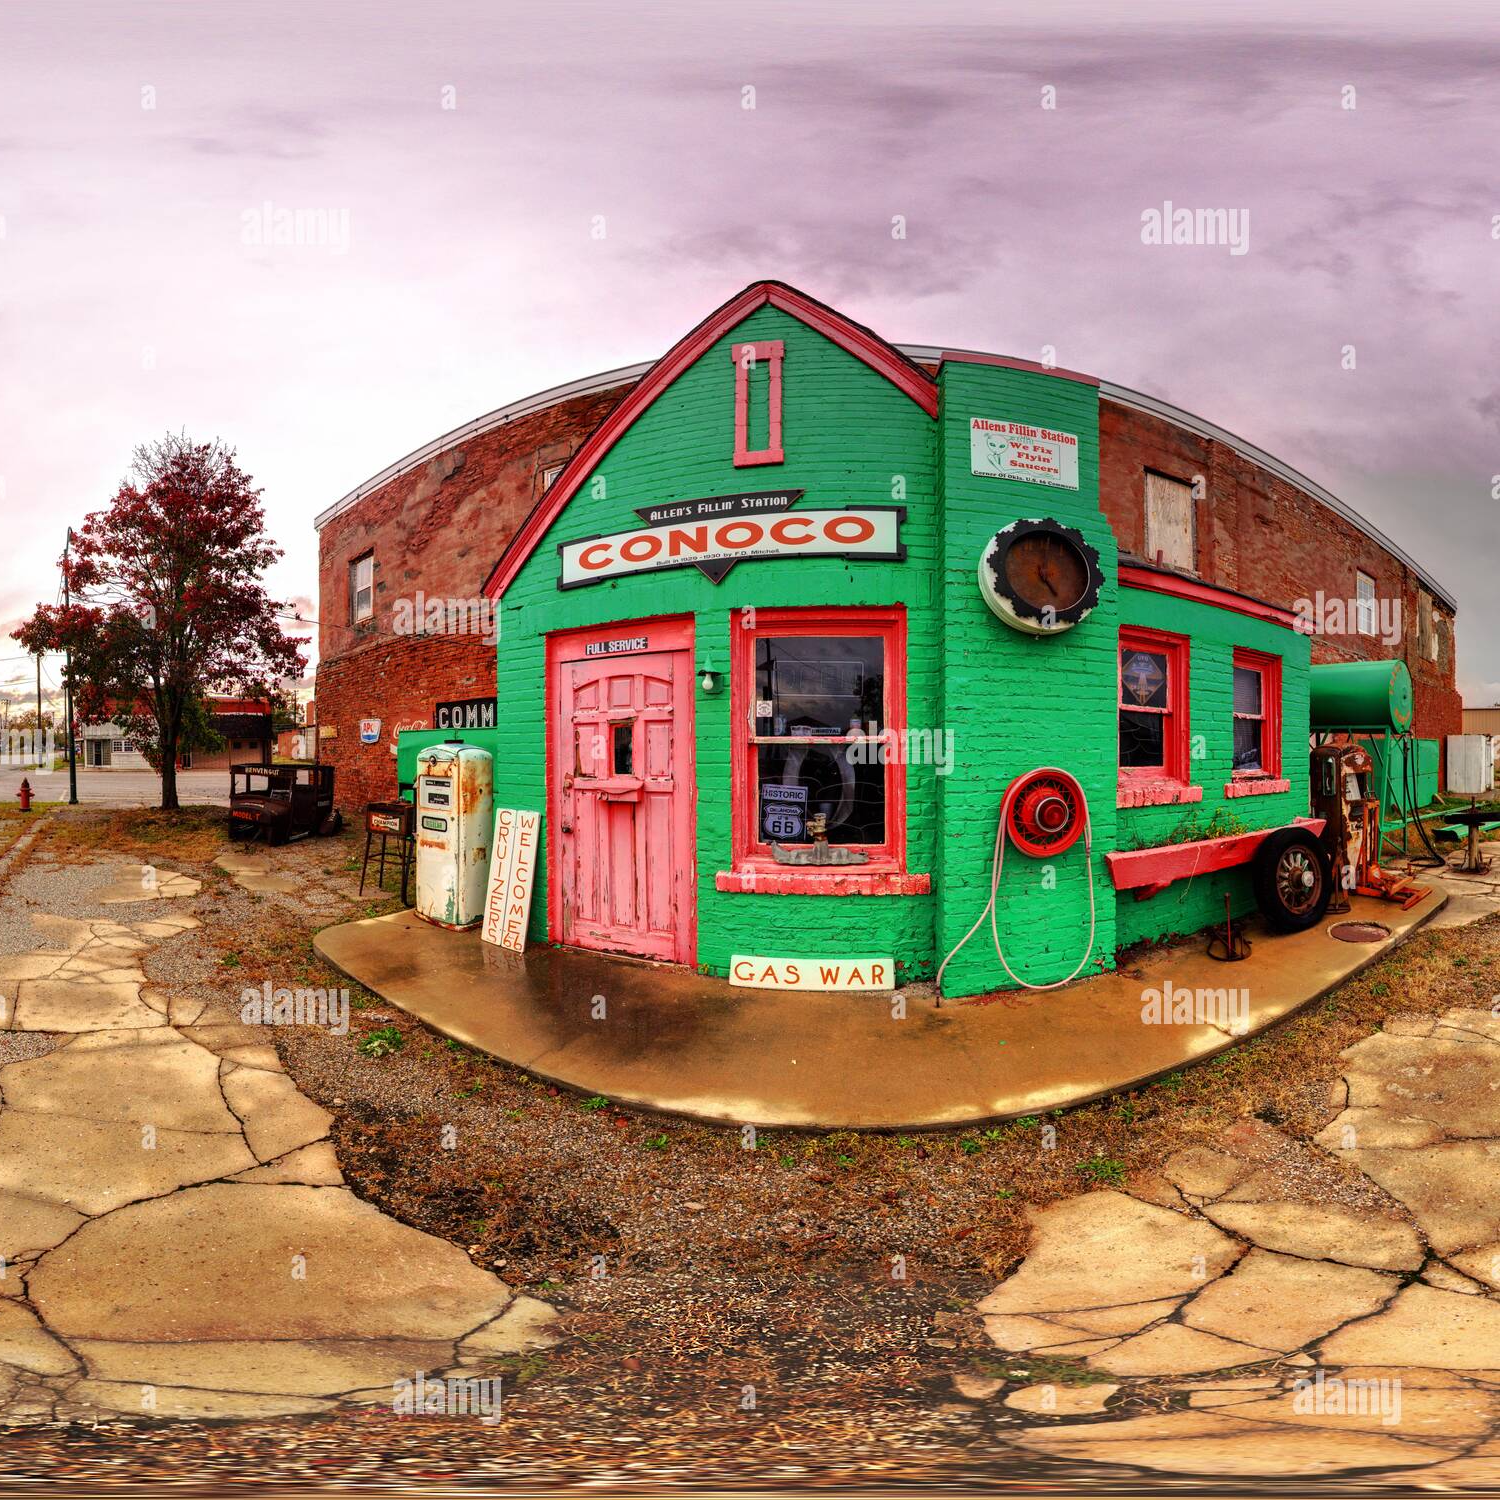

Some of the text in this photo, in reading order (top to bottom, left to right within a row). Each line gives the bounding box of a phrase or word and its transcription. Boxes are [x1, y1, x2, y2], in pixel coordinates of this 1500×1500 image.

[972, 419, 1077, 446] Allens Fillin' Station
[1009, 441, 1053, 455] We Fix
[1017, 451, 1053, 464] Flyin'
[1009, 459, 1059, 474] Saucers
[650, 496, 788, 521] ALLEN'S FILLIN' STATION
[578, 516, 875, 570] CONOCO
[586, 637, 646, 656] FULL SERVICE
[438, 703, 494, 729] COMM
[764, 790, 804, 800] HISTORIC
[772, 820, 794, 834] 66
[488, 810, 512, 943] CRUIZERS
[507, 815, 535, 935] WELCOME
[503, 932, 523, 951] 66
[734, 961, 885, 985] GAS WAR
